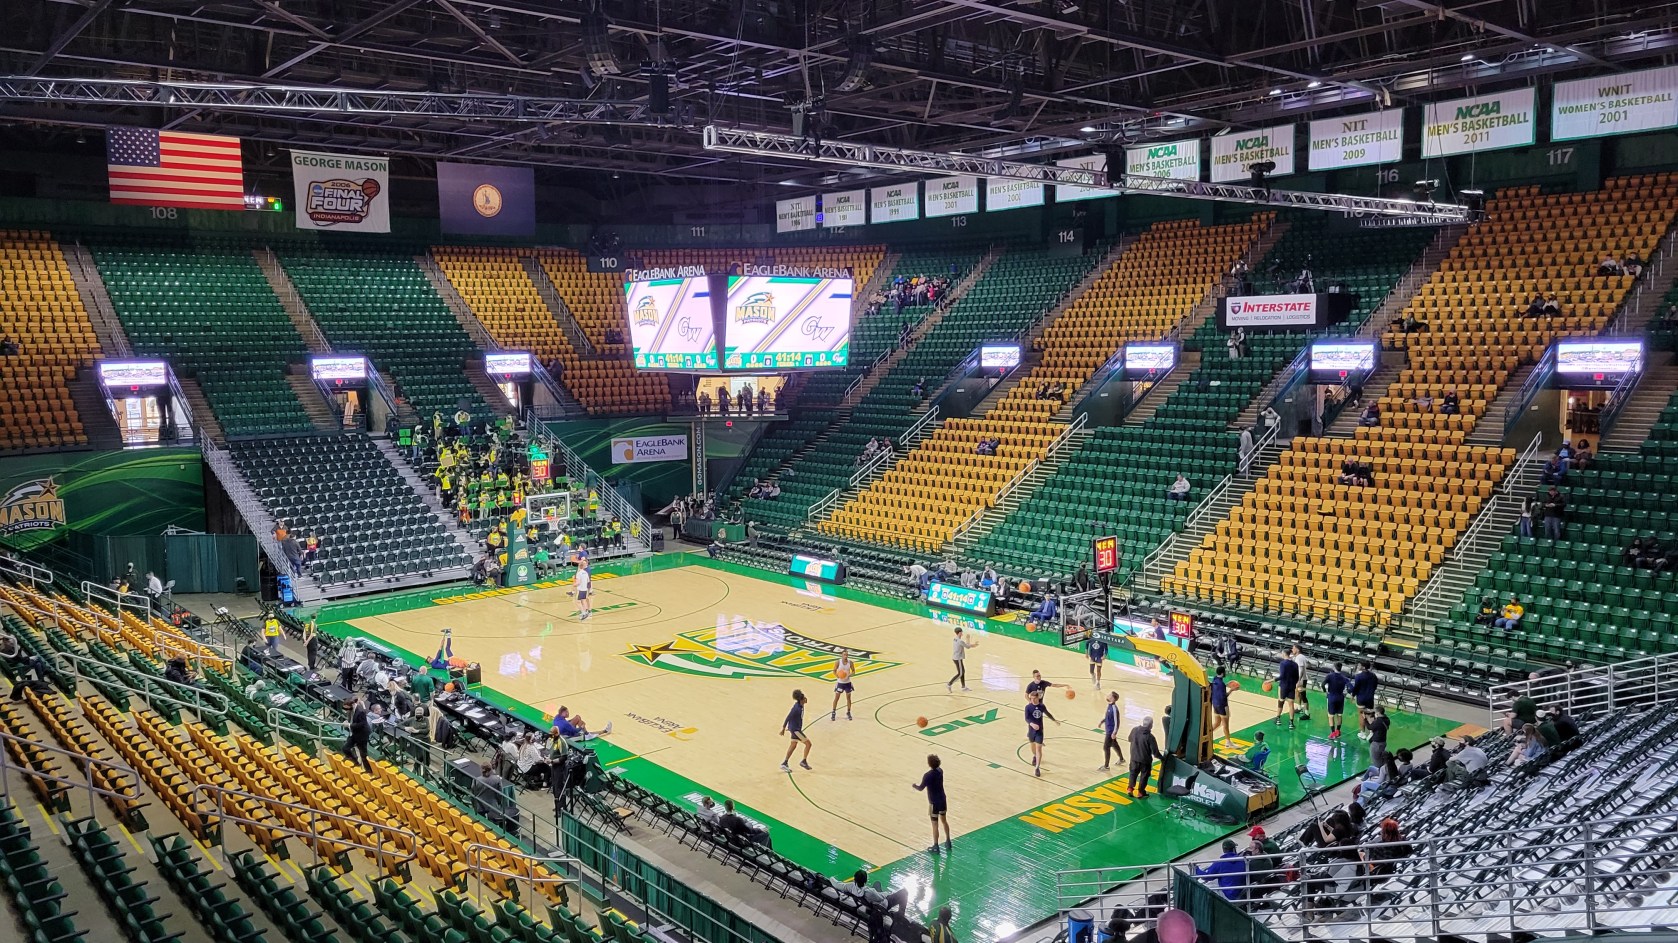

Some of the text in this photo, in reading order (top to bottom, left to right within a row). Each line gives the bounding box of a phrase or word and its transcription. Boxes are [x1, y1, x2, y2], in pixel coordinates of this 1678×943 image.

[1598, 84, 1632, 97] WNIT
[1455, 101, 1500, 120] NCAA
[1558, 93, 1673, 114] WOMEN'S BASKETBALL
[1427, 112, 1529, 136] MEN'S BASKETBALL
[1599, 110, 1628, 124] 2001
[1341, 120, 1368, 133] NIT
[1235, 136, 1269, 151] NCAA
[1312, 129, 1398, 150] MEN'S BASKETBALL
[1464, 131, 1490, 144] 2011
[1147, 145, 1178, 160] NCAA
[1214, 146, 1290, 165] MEN'S BASKETBALL
[1343, 149, 1366, 160] 2009
[1546, 148, 1574, 165] 117
[294, 156, 387, 172] GEORGE MASON
[1129, 155, 1197, 173] MEN'S BASKETBALL
[1153, 169, 1171, 178] 2006
[1376, 169, 1399, 184] 116
[324, 188, 364, 199] FINAL
[310, 196, 364, 211] FOUR
[150, 207, 177, 219] 108
[313, 213, 360, 221] INDIANAPOLIS
[951, 216, 967, 227] 113
[691, 227, 705, 237] 111
[1058, 230, 1075, 243] 114
[600, 257, 618, 268] 110
[735, 306, 776, 321] MASON
[801, 315, 835, 342] GW
[775, 352, 802, 362] 41:14
[1099, 550, 1113, 567] 30
[1174, 624, 1187, 634] 30
[1173, 775, 1227, 805] MKay
